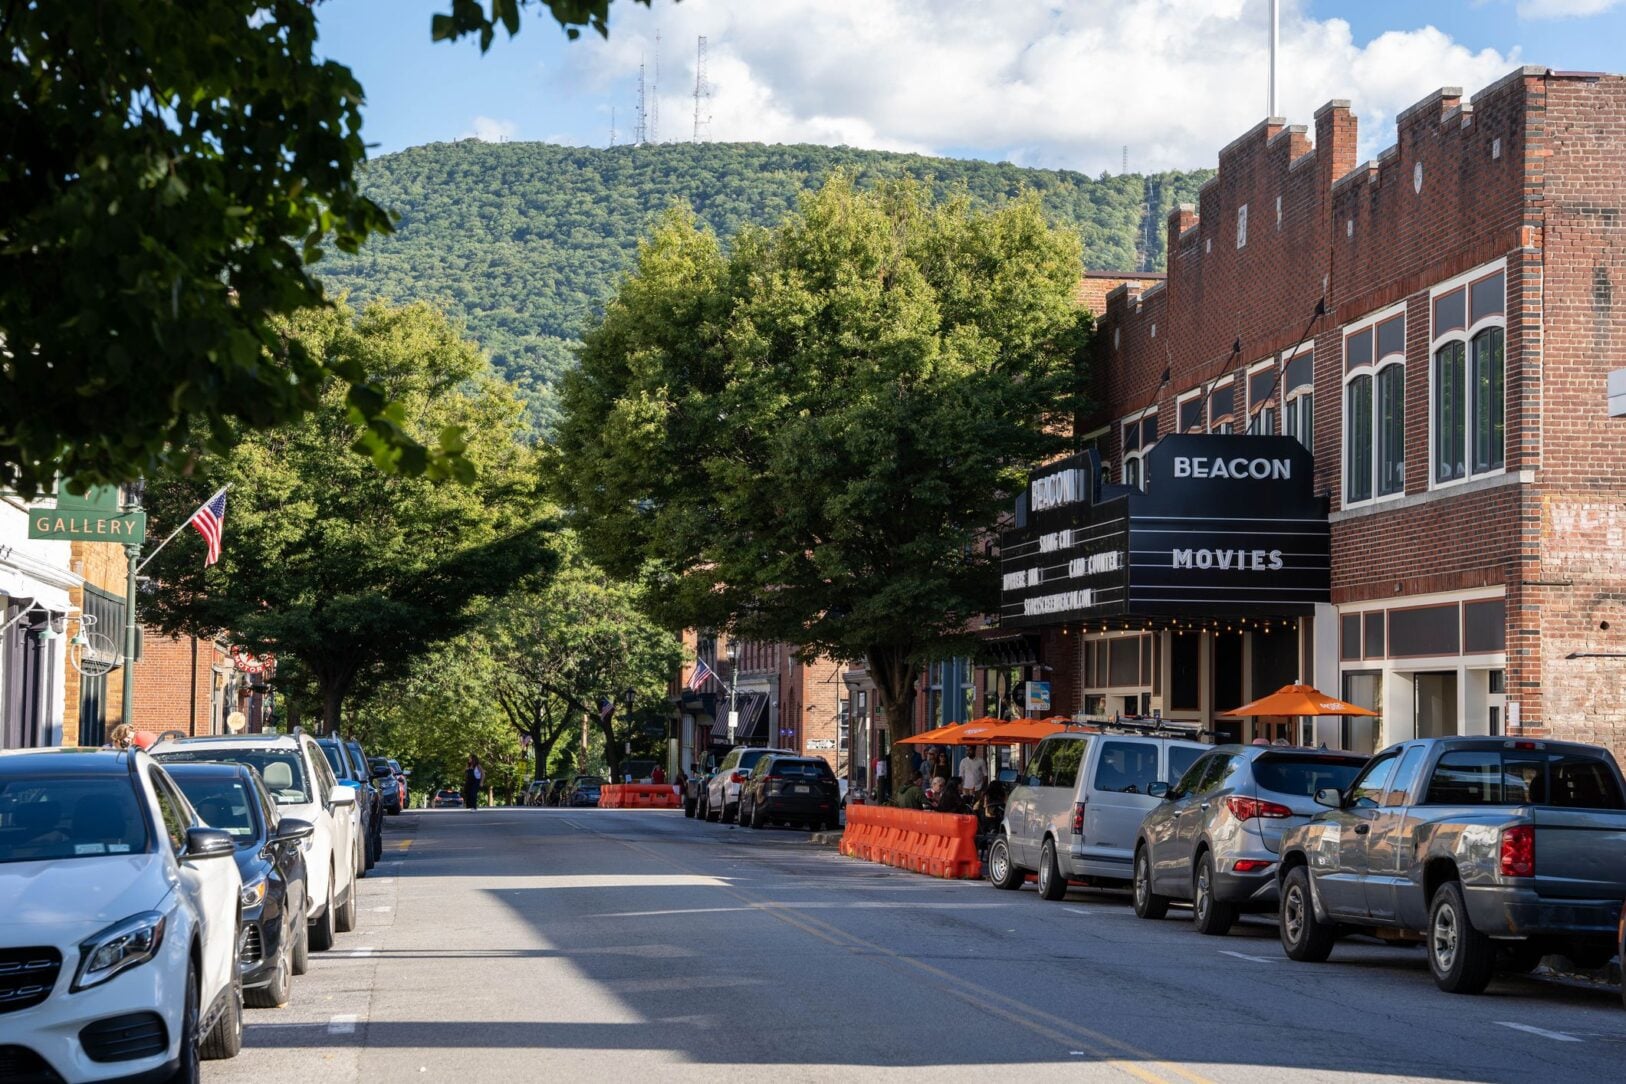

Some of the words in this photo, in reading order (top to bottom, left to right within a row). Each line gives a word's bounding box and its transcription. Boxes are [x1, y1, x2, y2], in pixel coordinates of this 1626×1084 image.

[1174, 456, 1291, 480] BEACON
[1032, 469, 1077, 511] BEACON
[36, 517, 136, 535] GALLERY
[1172, 548, 1284, 571] MOVIES
